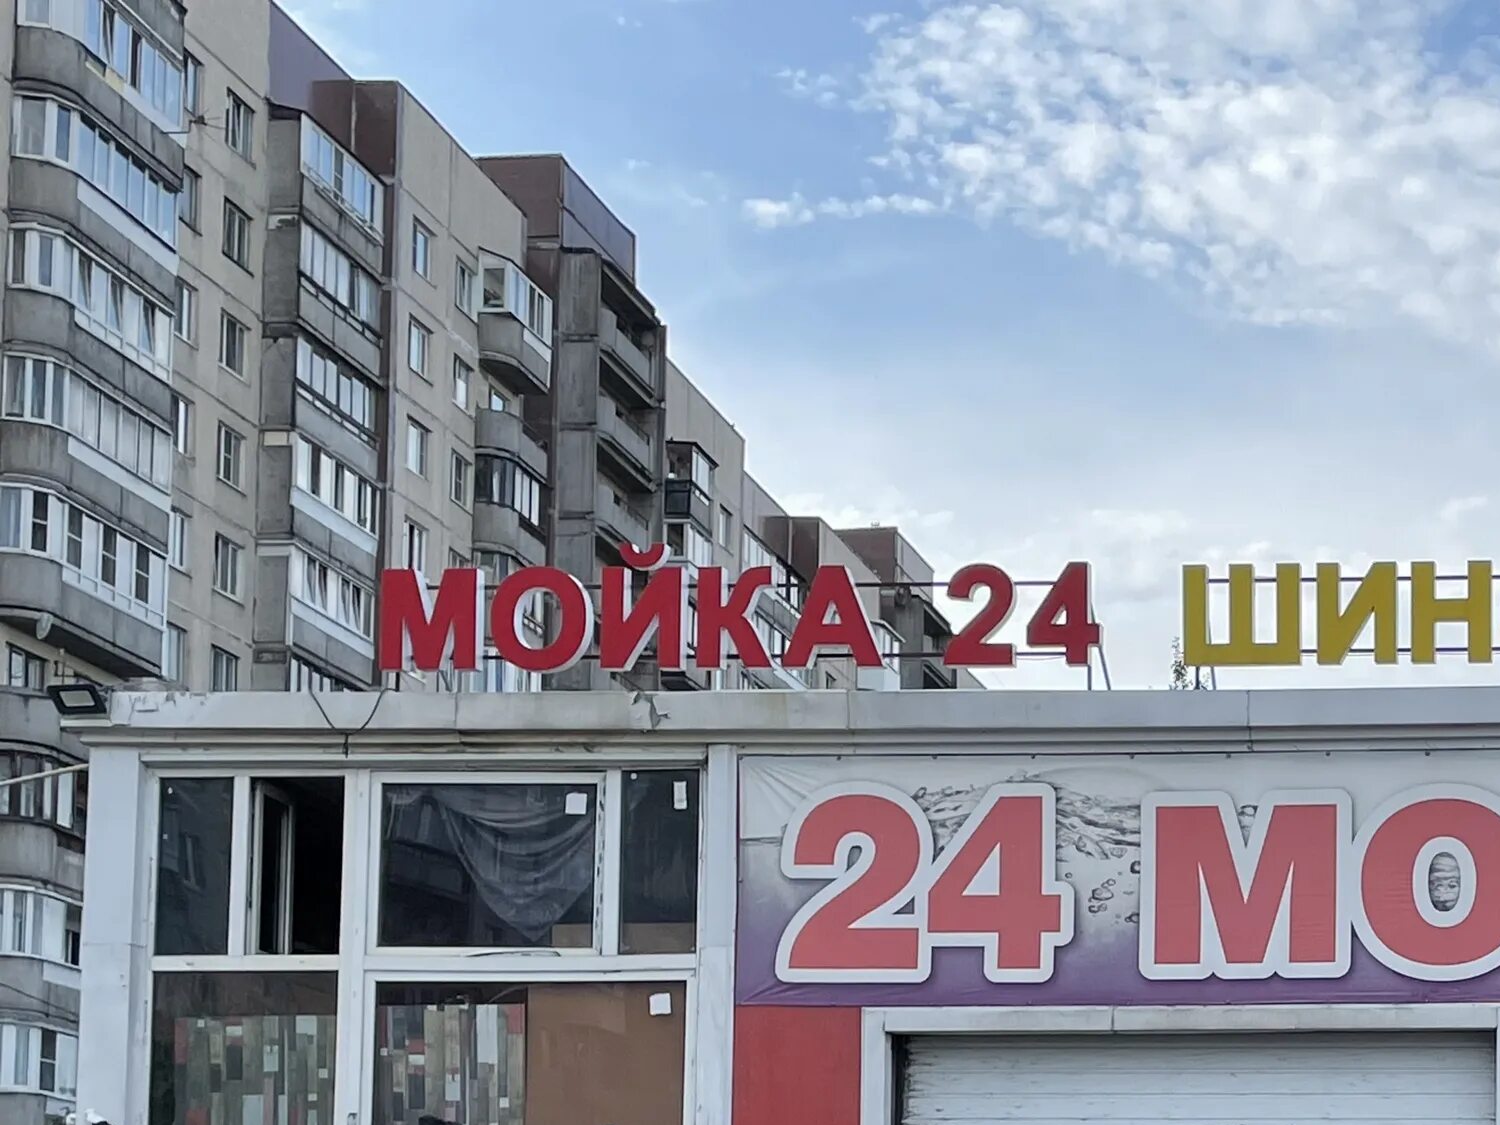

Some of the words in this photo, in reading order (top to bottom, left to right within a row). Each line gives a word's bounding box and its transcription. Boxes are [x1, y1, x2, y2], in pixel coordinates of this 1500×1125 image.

[378, 541, 892, 673] МОЙКА
[942, 560, 1102, 671] 24
[780, 784, 1070, 980] 24
